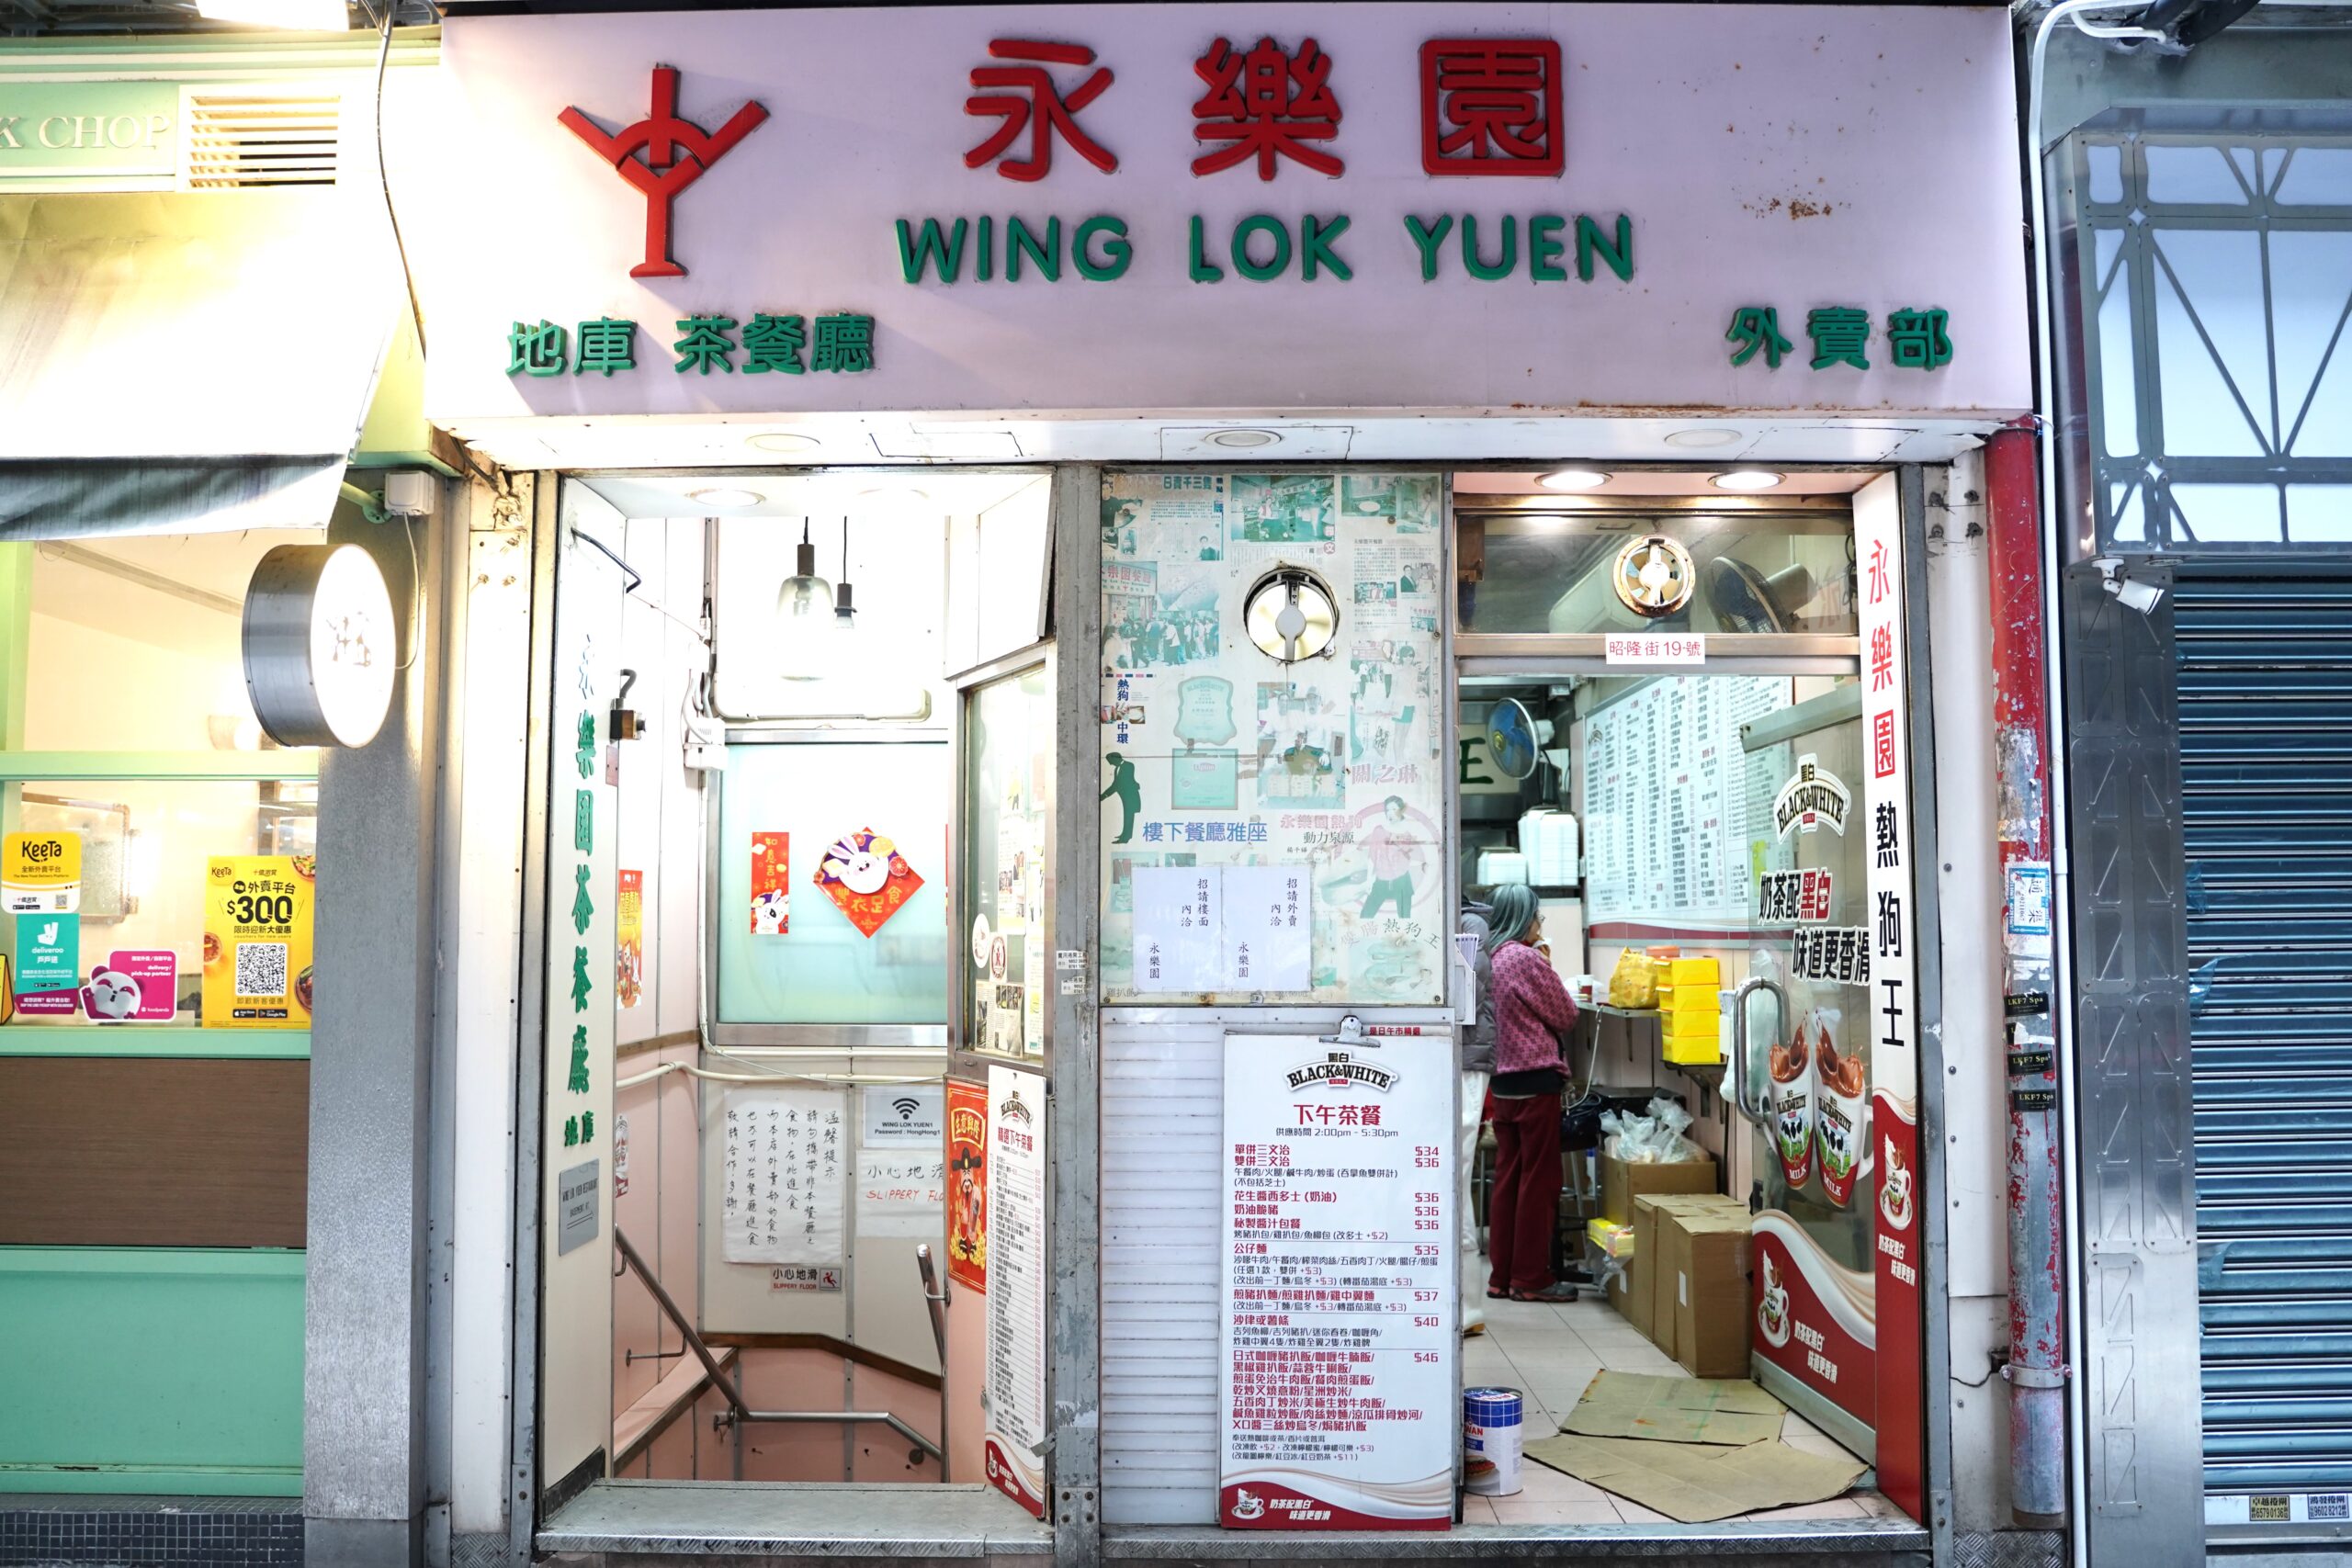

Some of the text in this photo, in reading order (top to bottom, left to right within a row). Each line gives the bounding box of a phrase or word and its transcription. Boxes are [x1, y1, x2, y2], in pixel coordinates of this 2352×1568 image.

[964, 37, 1566, 183] 永樂園
[39, 115, 172, 150] CHOP
[895, 213, 1635, 285] WING LOK YUEN
[505, 313, 875, 378] 地庫 茶餐廳
[1724, 305, 1955, 373] 外賣部
[1116, 679, 1130, 702] 熱狗
[1115, 721, 1130, 745] 中環
[1351, 763, 1419, 785] 關之琳
[1868, 538, 1905, 1047] 永樂園熱狗王
[1776, 784, 1845, 835] BLACK&WHITE
[1280, 814, 1363, 829] 永樂園熱狗
[1142, 821, 1268, 843] 樓下餐廳雅座
[1303, 830, 1355, 845] 動力泉源
[21, 840, 62, 863] KeeTa
[211, 866, 232, 878] KeeTa
[247, 880, 296, 896] 外賣平台
[226, 895, 293, 925] $300
[1197, 877, 1210, 928] 招請樓面
[1286, 877, 1298, 928] 招請外賣
[1148, 942, 1161, 980] 永樂園
[1238, 942, 1250, 979] 永樂園
[1792, 927, 1871, 983] 味道更香滑
[2029, 996, 2043, 1005] Spa
[1286, 1064, 1391, 1089] BLACK&WHITE
[1293, 1104, 1382, 1126] 下午茶餐
[1275, 1127, 1312, 1137] 供應時間
[1314, 1128, 1351, 1138] 2:00pm
[1361, 1128, 1399, 1138] 5:30pm
[1234, 1144, 1291, 1156] 單併三文治
[1414, 1145, 1440, 1156] $34
[1234, 1156, 1291, 1168] 雙併三文治
[1414, 1157, 1440, 1168] $36
[1788, 1163, 1807, 1180] MILK
[1234, 1178, 1286, 1188] (不包括芝士)
[1823, 1173, 1843, 1197] MILK
[865, 1190, 921, 1201] SLIPPERY
[1233, 1190, 1338, 1203] 花生醬西多士 (奶油)
[1414, 1192, 1440, 1203] $36
[1414, 1205, 1440, 1217] $36
[1414, 1219, 1440, 1230] $36
[1233, 1242, 1268, 1255] 公仔麵
[1413, 1245, 1440, 1256] $35
[773, 1268, 819, 1281] 小心地滑
[1299, 1266, 1323, 1276] +$3)
[773, 1282, 818, 1291] SLIPPERY FLOOR
[1390, 1277, 1413, 1287] +$3)
[1413, 1291, 1439, 1303] $37
[1384, 1303, 1408, 1313] +$3)
[1413, 1316, 1439, 1327] $40
[1413, 1352, 1439, 1363] $46
